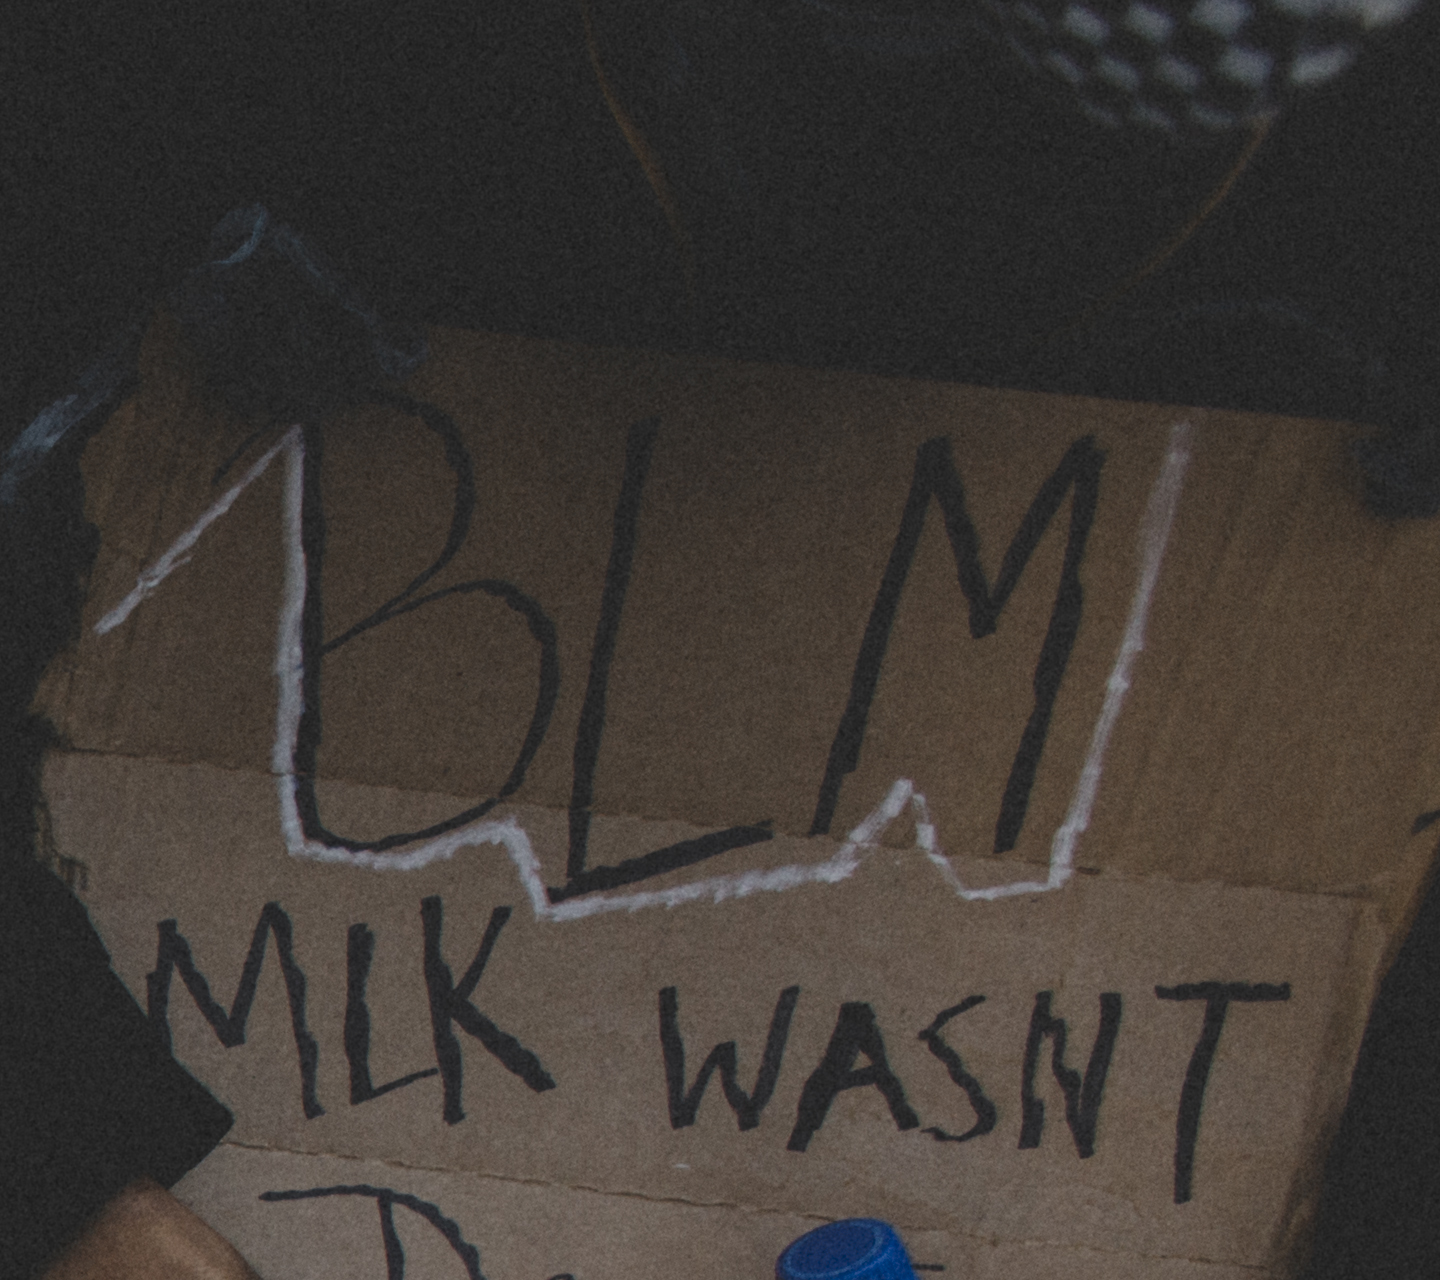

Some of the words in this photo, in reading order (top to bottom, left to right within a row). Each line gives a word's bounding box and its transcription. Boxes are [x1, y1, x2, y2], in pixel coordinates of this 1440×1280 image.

[214, 394, 1108, 904] BLM
[148, 896, 556, 1124] MLK
[660, 983, 1291, 1204] WASNT
